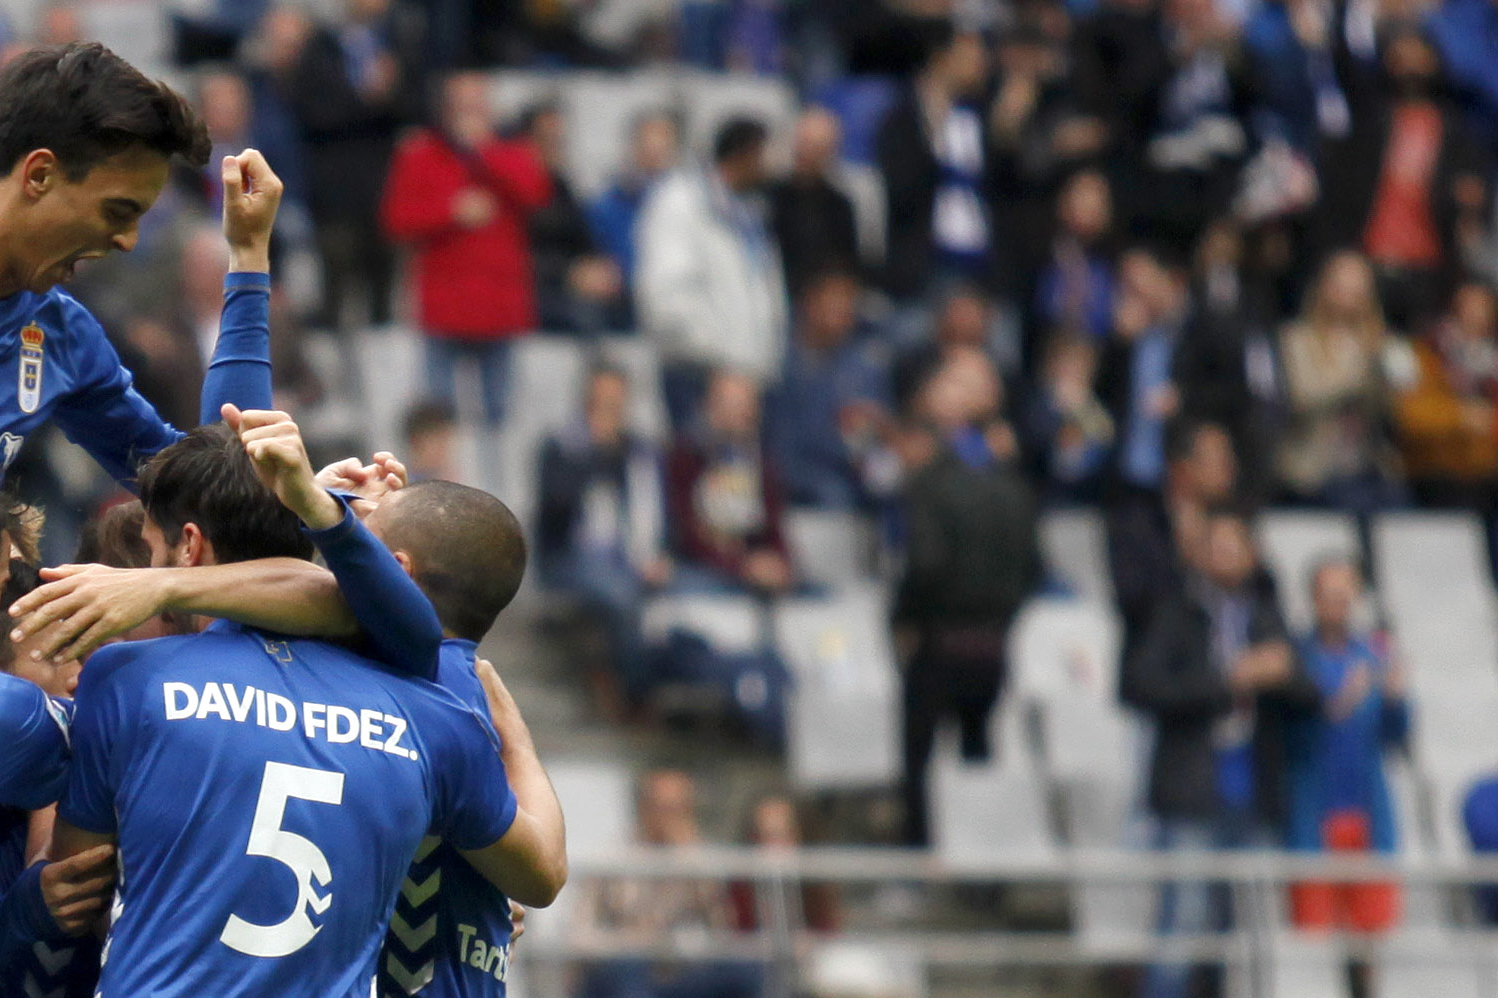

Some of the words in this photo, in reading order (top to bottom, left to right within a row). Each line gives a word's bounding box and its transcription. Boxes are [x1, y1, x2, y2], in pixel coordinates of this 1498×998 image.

[163, 687, 298, 731] DAVID
[303, 702, 419, 761] FDEZ.
[220, 761, 345, 957] 5
